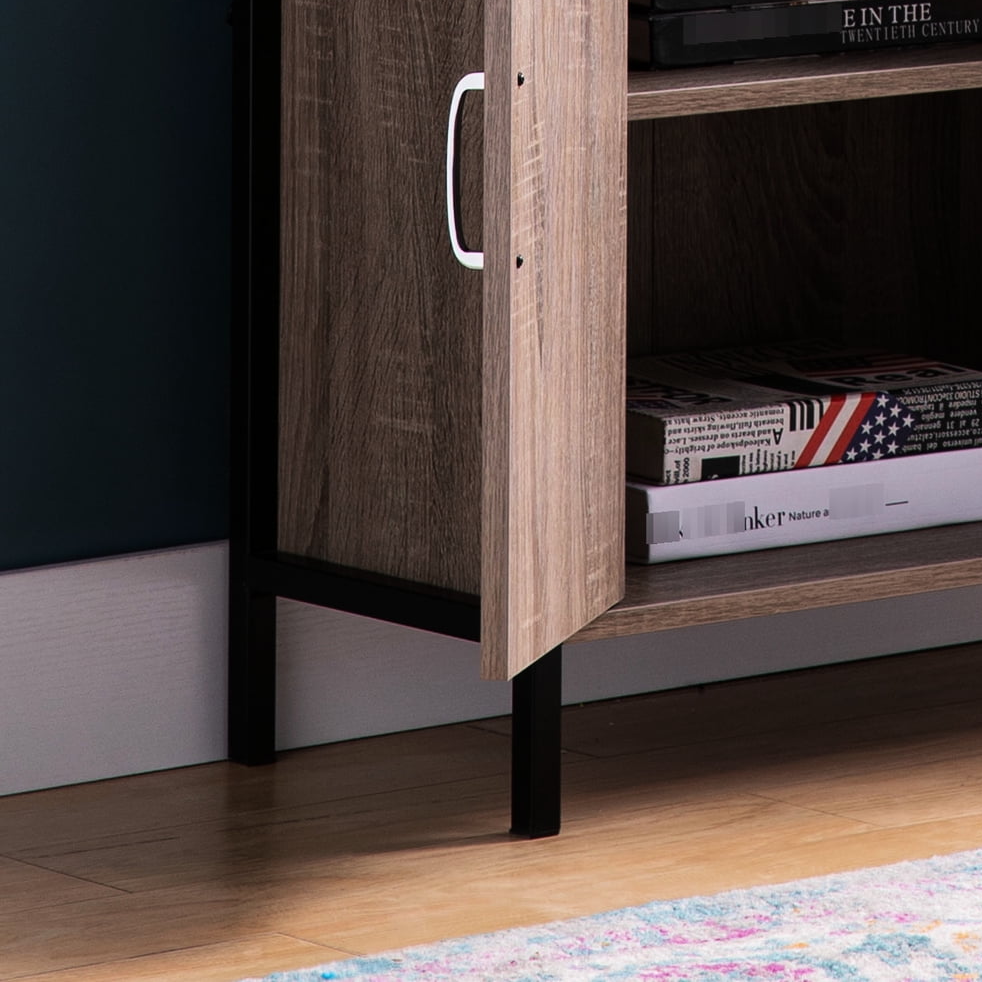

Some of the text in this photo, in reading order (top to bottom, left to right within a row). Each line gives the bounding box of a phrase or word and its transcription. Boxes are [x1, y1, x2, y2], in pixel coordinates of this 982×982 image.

[860, 6, 883, 26] IN
[888, 2, 932, 24] THE
[840, 18, 980, 45] TWENTIETH CENTURY
[749, 408, 784, 418] romantic
[674, 416, 691, 425] hats
[692, 414, 716, 423] Straw
[753, 418, 784, 428] beneath
[668, 428, 682, 436] and
[683, 426, 706, 435] skirts
[731, 430, 756, 440] hearts
[758, 429, 771, 437] and
[668, 437, 687, 445] Lace
[707, 444, 716, 452] of
[788, 509, 822, 522] Nature
